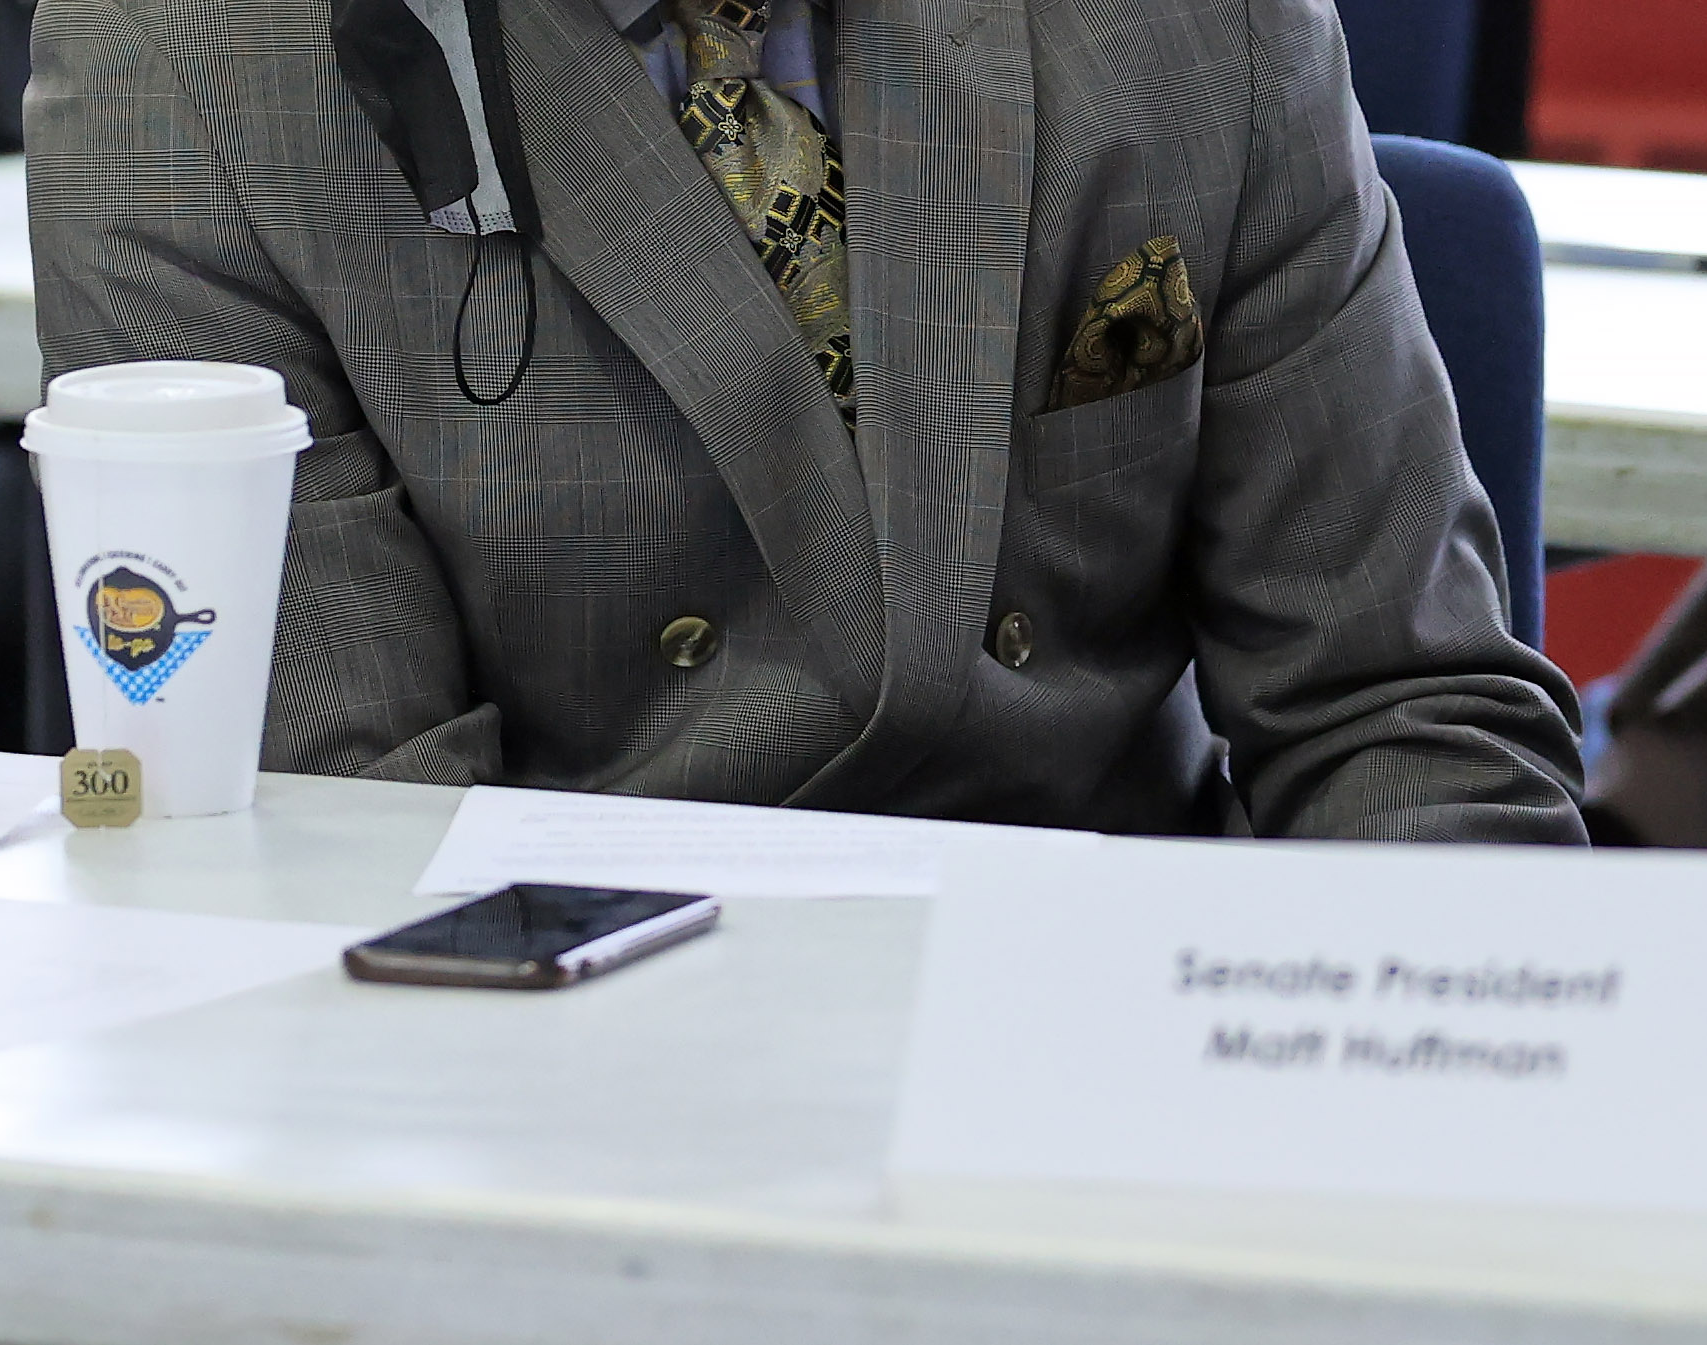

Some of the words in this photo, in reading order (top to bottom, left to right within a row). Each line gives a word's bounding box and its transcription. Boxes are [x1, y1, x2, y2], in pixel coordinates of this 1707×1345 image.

[1175, 949, 1358, 1000] Senate
[1373, 955, 1622, 1007] President
[1202, 1024, 1328, 1070] Matt
[1340, 1028, 1569, 1080] Huffman
